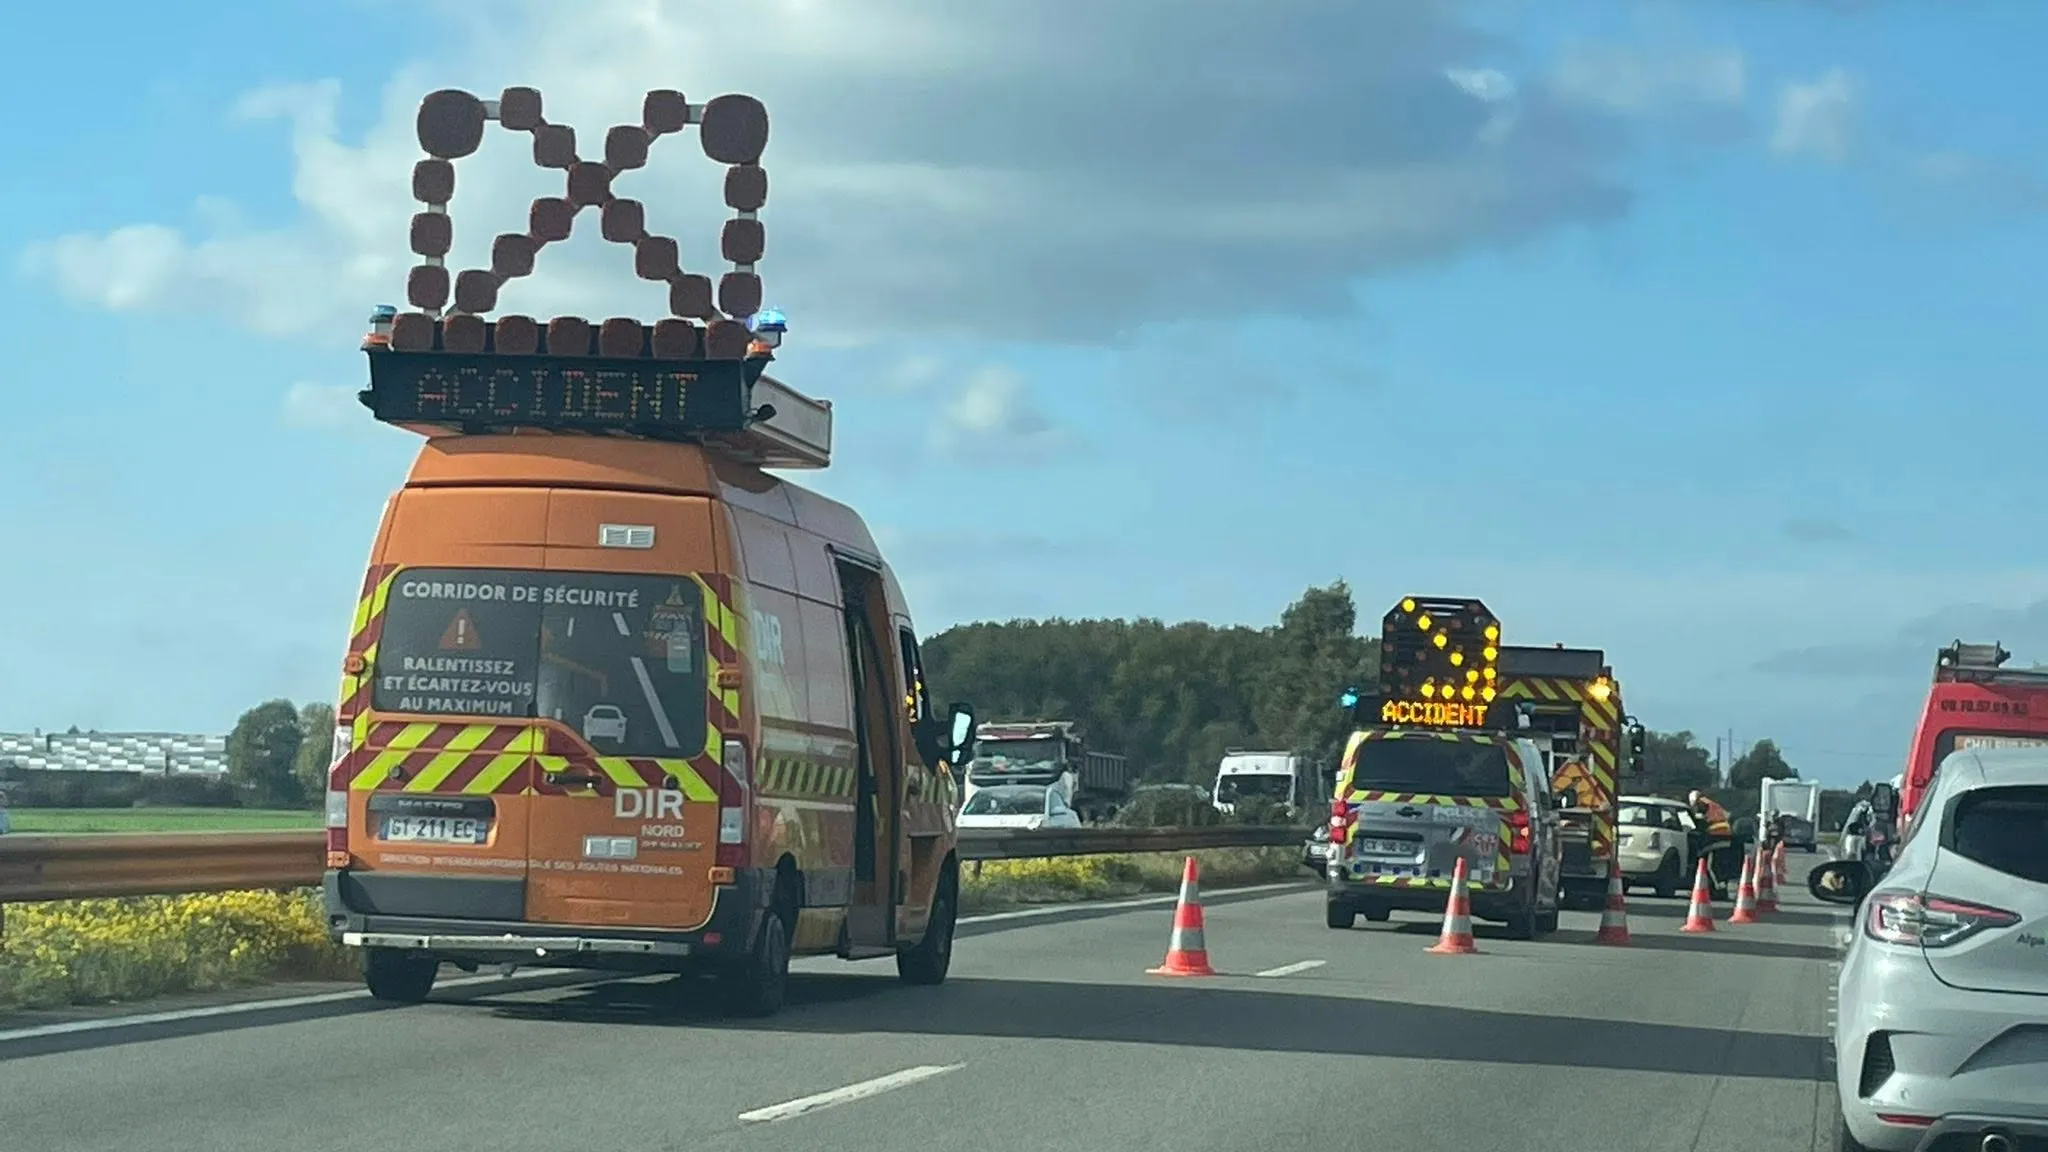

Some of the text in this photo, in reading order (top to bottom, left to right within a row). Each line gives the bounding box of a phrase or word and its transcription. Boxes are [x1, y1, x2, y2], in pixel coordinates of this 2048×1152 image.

[417, 368, 698, 420] ACCIDENT
[402, 582, 639, 608] CORRIDOR DE SÉCURITÉ
[403, 656, 514, 675] RALENTISSEZ
[384, 674, 532, 696] ET ÉCARTEZ-VOUS
[400, 697, 512, 714] AU MAXIMUM
[1382, 700, 1488, 726] ACCIDENT
[615, 788, 684, 819] DIR
[641, 824, 685, 837] NORD
